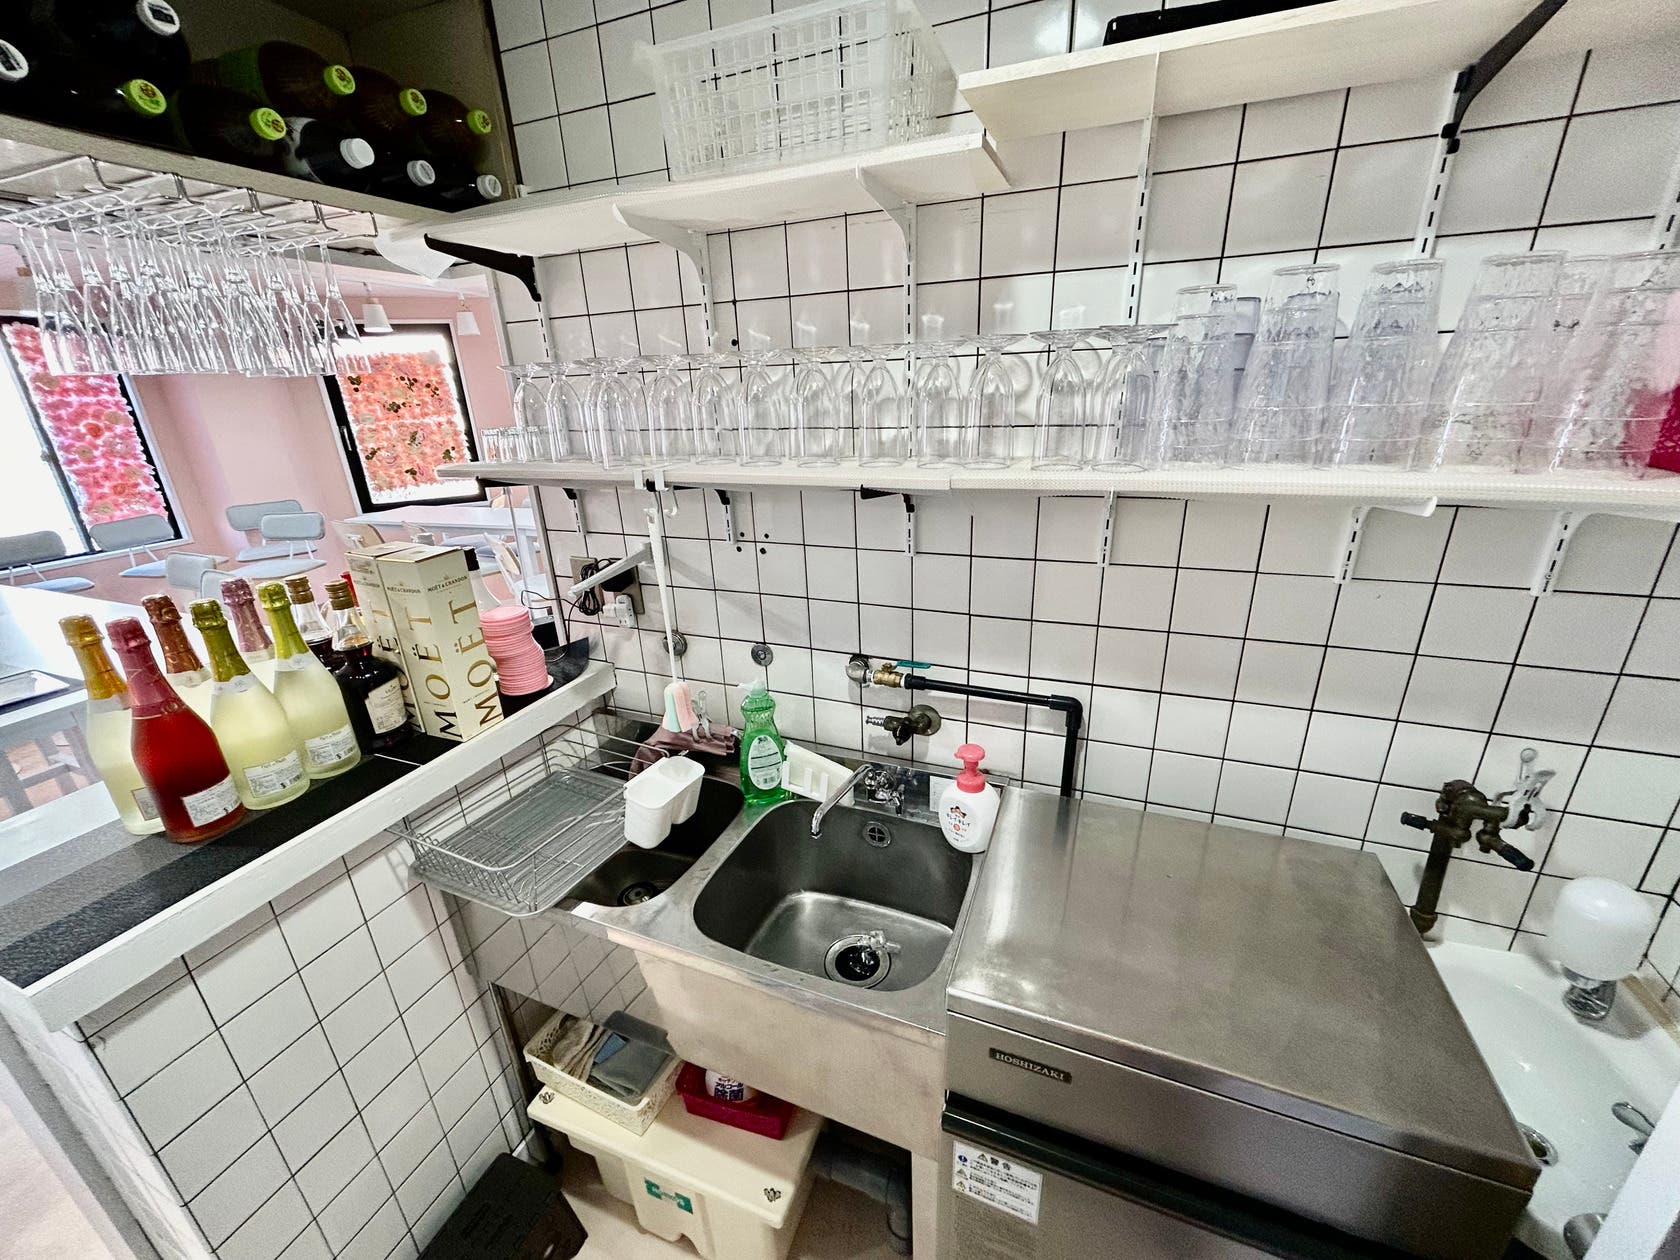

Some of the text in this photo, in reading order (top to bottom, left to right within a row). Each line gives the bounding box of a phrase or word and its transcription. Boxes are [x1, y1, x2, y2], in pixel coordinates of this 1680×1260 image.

[404, 606, 463, 739] MOËT
[448, 600, 504, 727] MOËT
[995, 1052, 1065, 1081] HOSHIZAKI
